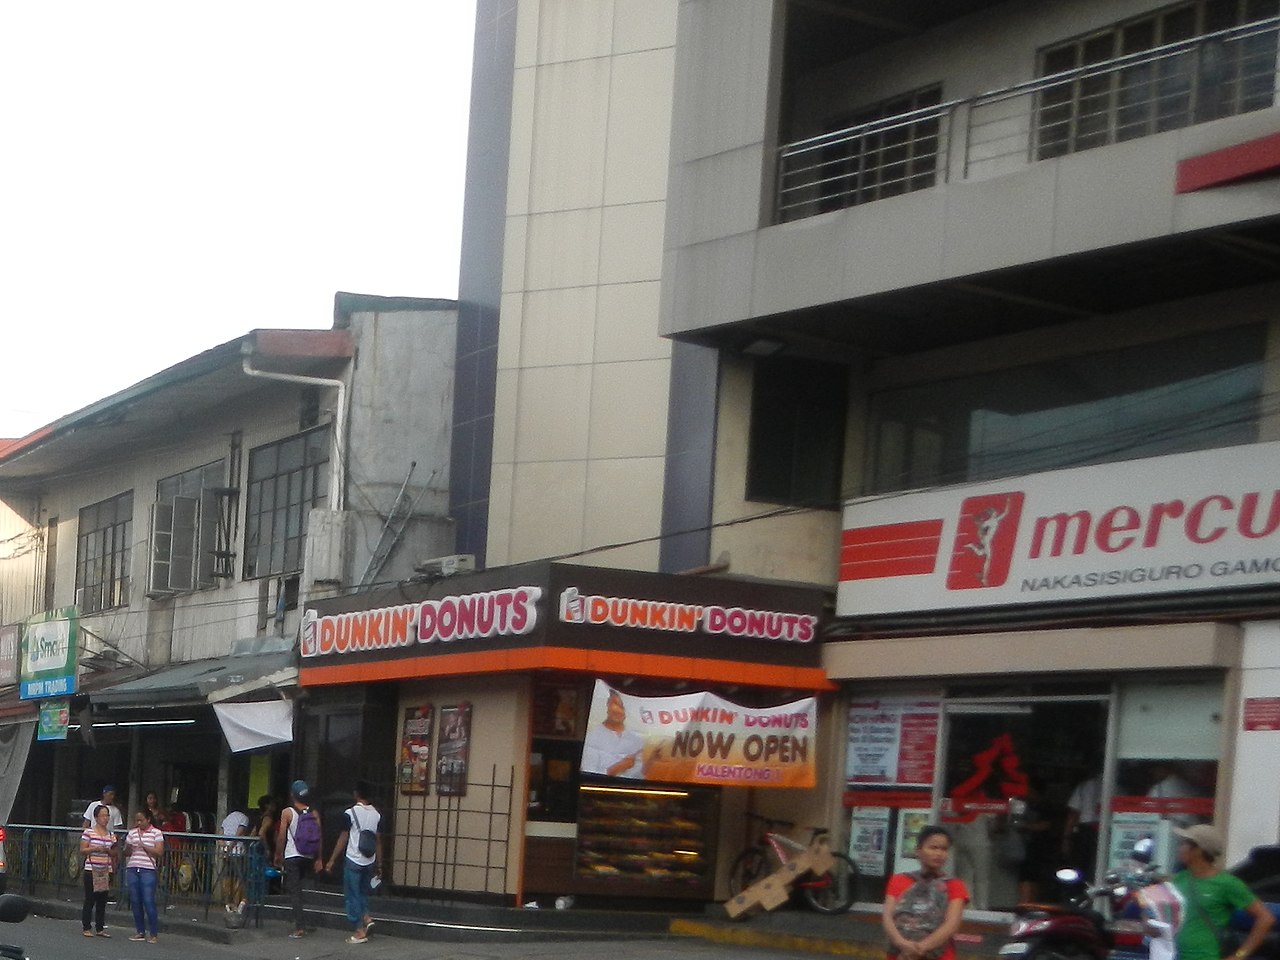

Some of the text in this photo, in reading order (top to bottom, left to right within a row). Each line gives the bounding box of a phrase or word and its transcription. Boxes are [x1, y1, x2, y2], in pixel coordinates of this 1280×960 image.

[1028, 489, 1280, 560] mercu
[1020, 563, 1203, 593] NAKASISIGURO
[320, 591, 529, 653] DUNKIN' DONUTS
[590, 597, 816, 642] DUNKIN' DONUTS
[39, 634, 65, 658] Smart
[658, 706, 809, 730] DUNKIN' DONUTS
[671, 729, 809, 763] NOW OPEN
[696, 763, 772, 781] KALENTONG
